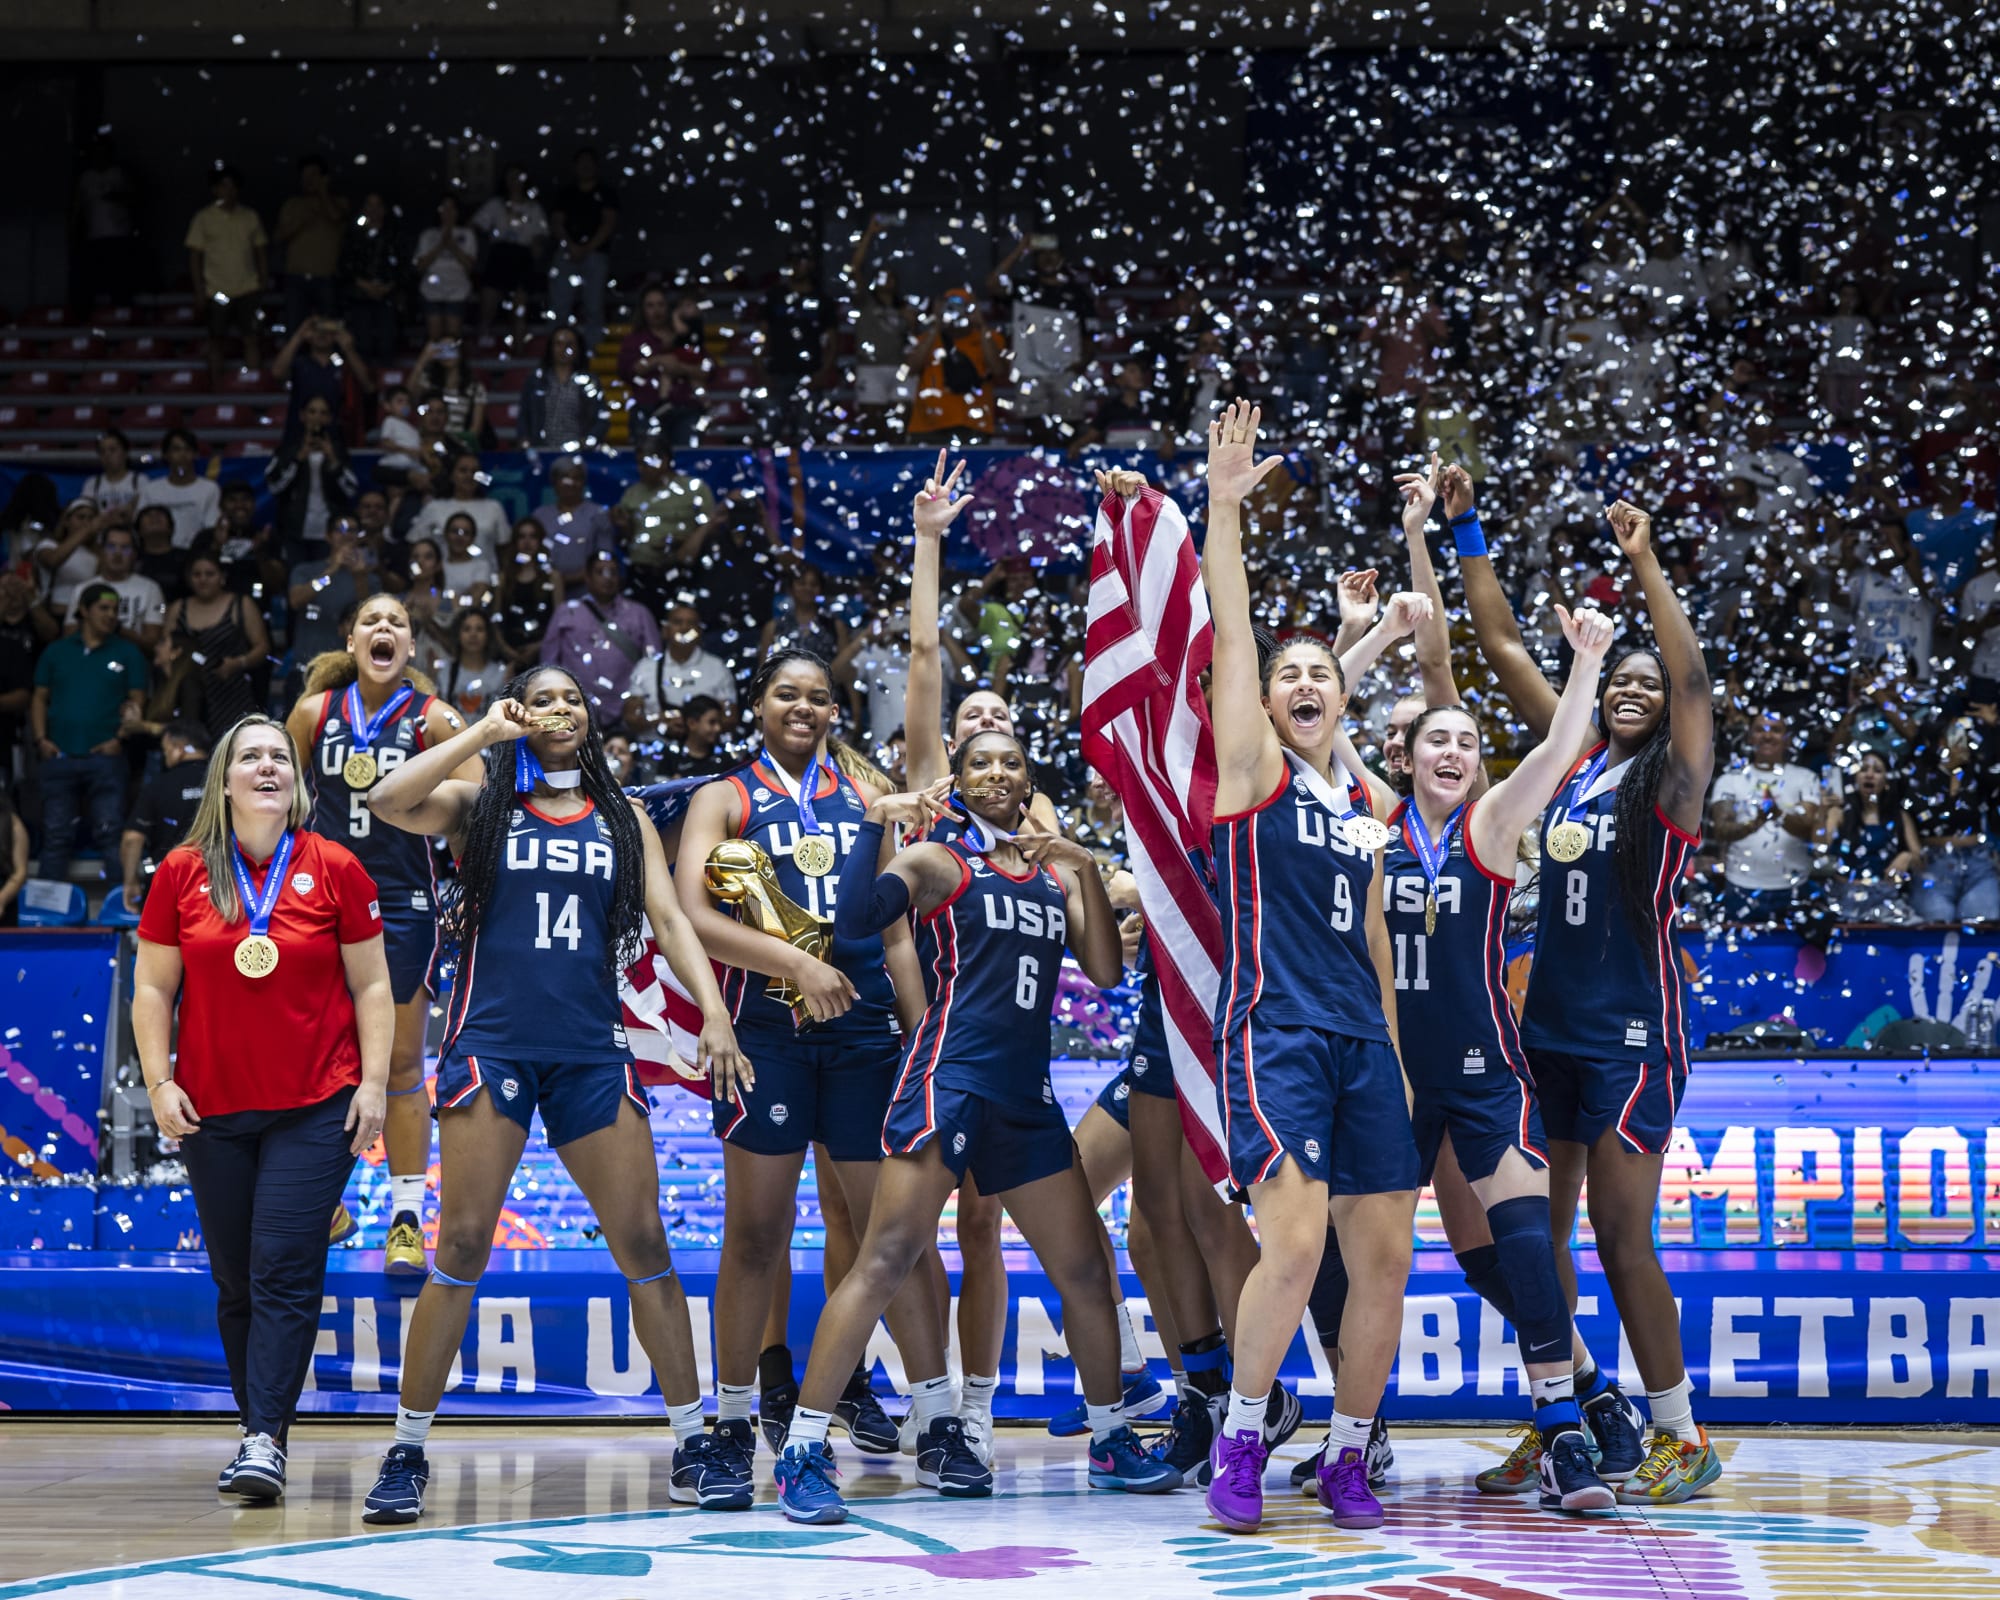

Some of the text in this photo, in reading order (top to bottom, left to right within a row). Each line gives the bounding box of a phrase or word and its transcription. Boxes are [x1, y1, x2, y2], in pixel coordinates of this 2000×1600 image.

[322, 744, 407, 777] UA
[350, 791, 371, 838] 5
[507, 837, 614, 881] USA
[534, 892, 582, 950] 14
[984, 894, 1067, 945] USA
[1331, 873, 1354, 932] 9
[1565, 869, 1589, 926] 8
[1015, 955, 1039, 1010] 6
[1395, 934, 1430, 990] 11
[1467, 1048, 1481, 1056] 42
[1630, 1020, 1644, 1029] 46
[1577, 1126, 2000, 1244] MPIO
[1397, 1295, 2000, 1399] BAETBA
